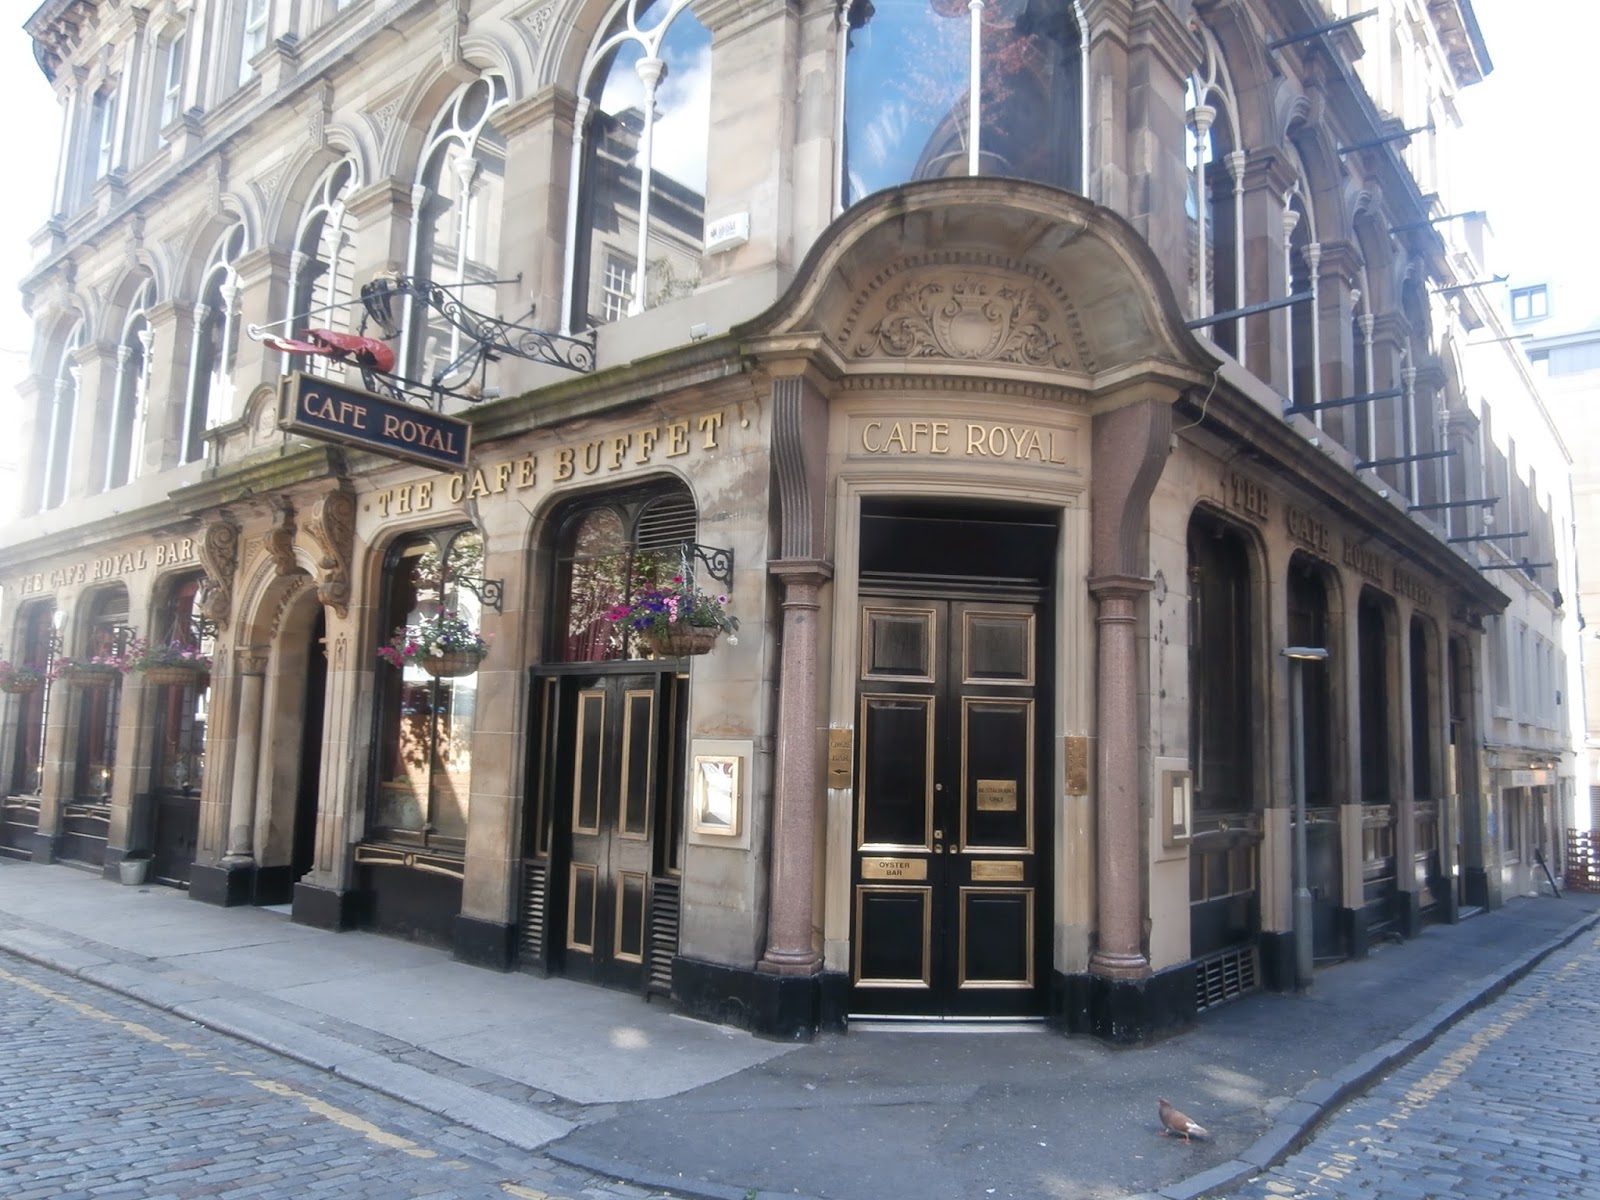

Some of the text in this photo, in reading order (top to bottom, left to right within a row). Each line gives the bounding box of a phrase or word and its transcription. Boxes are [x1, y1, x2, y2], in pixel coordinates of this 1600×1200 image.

[303, 392, 458, 455] CAFE ROYAL
[862, 421, 1066, 465] CAFE ROYAL
[378, 481, 433, 518] THE
[553, 411, 724, 482] BUFFET
[1230, 472, 1269, 521] THE
[1285, 505, 1330, 554] CAFE
[19, 538, 194, 595] THE CAFE ROYAL BAR
[879, 861, 910, 869] OYSTER
